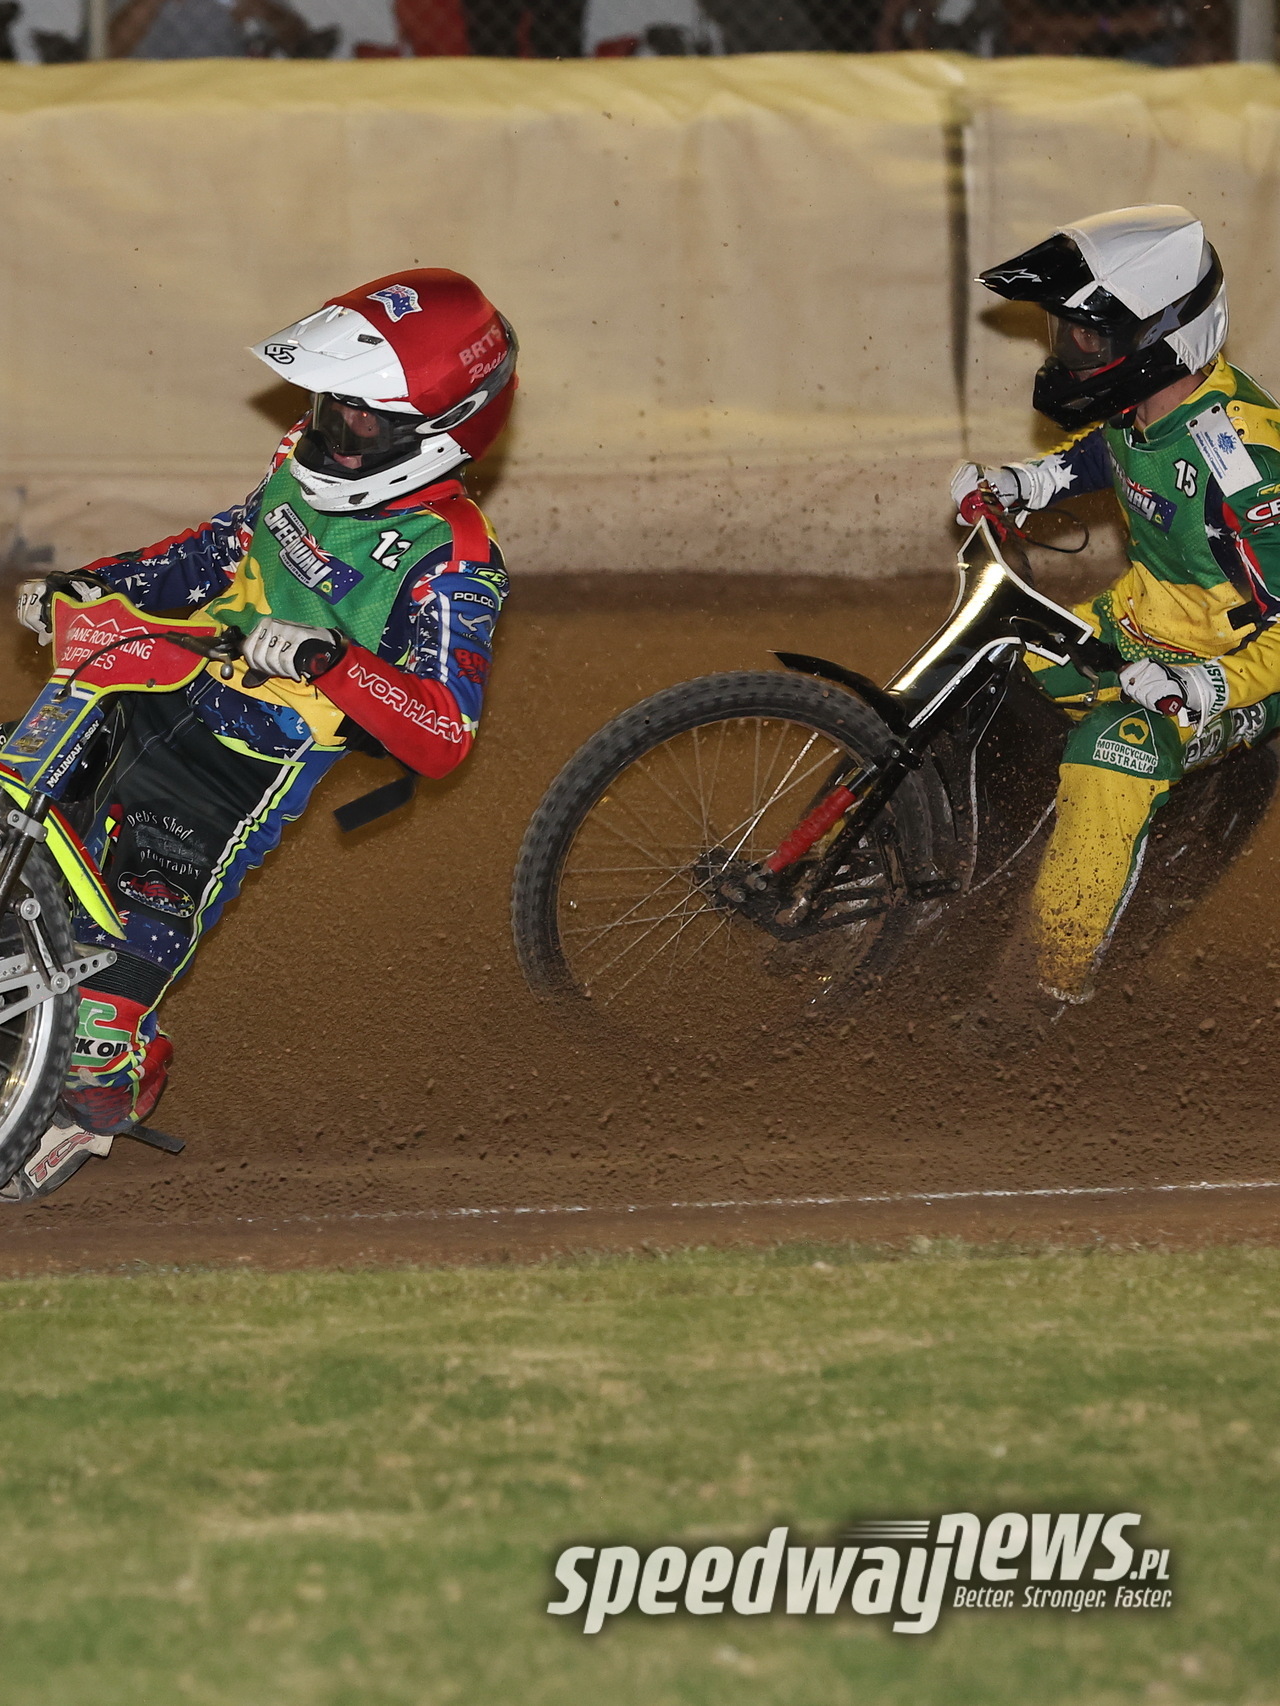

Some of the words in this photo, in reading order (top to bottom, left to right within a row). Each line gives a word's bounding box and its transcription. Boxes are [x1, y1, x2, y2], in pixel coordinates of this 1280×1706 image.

[1174, 458, 1198, 497] 15
[263, 502, 333, 588] SPEEDWAY
[370, 530, 411, 570] 12
[90, 629, 118, 646] ROOF
[347, 662, 408, 712] IVOR
[46, 742, 83, 789] MALINIAK
[1094, 749, 1153, 773] AUSTRALIA
[1097, 740, 1157, 766] MOTORCYCLING
[163, 816, 194, 841] Shed
